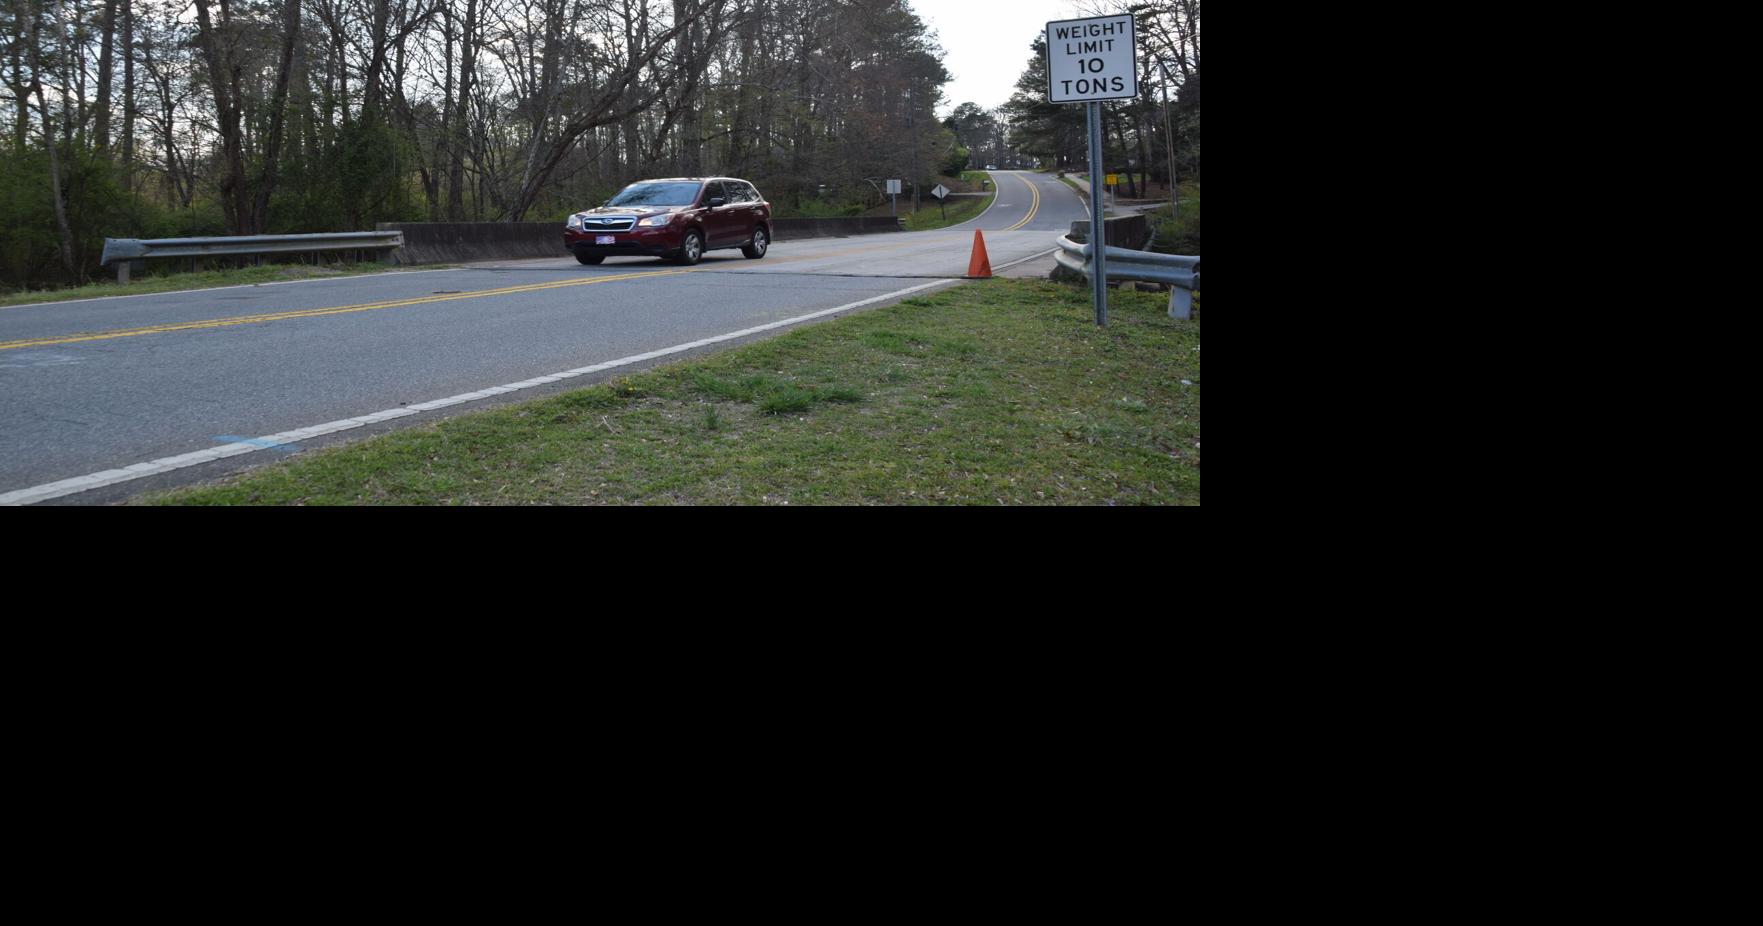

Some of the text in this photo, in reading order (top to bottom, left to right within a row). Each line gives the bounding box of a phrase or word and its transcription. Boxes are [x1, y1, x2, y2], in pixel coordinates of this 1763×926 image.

[1056, 21, 1126, 40] WEIGHT
[1066, 39, 1114, 55] LIMIT
[1078, 58, 1104, 74] 10
[1061, 76, 1124, 95] TONS
